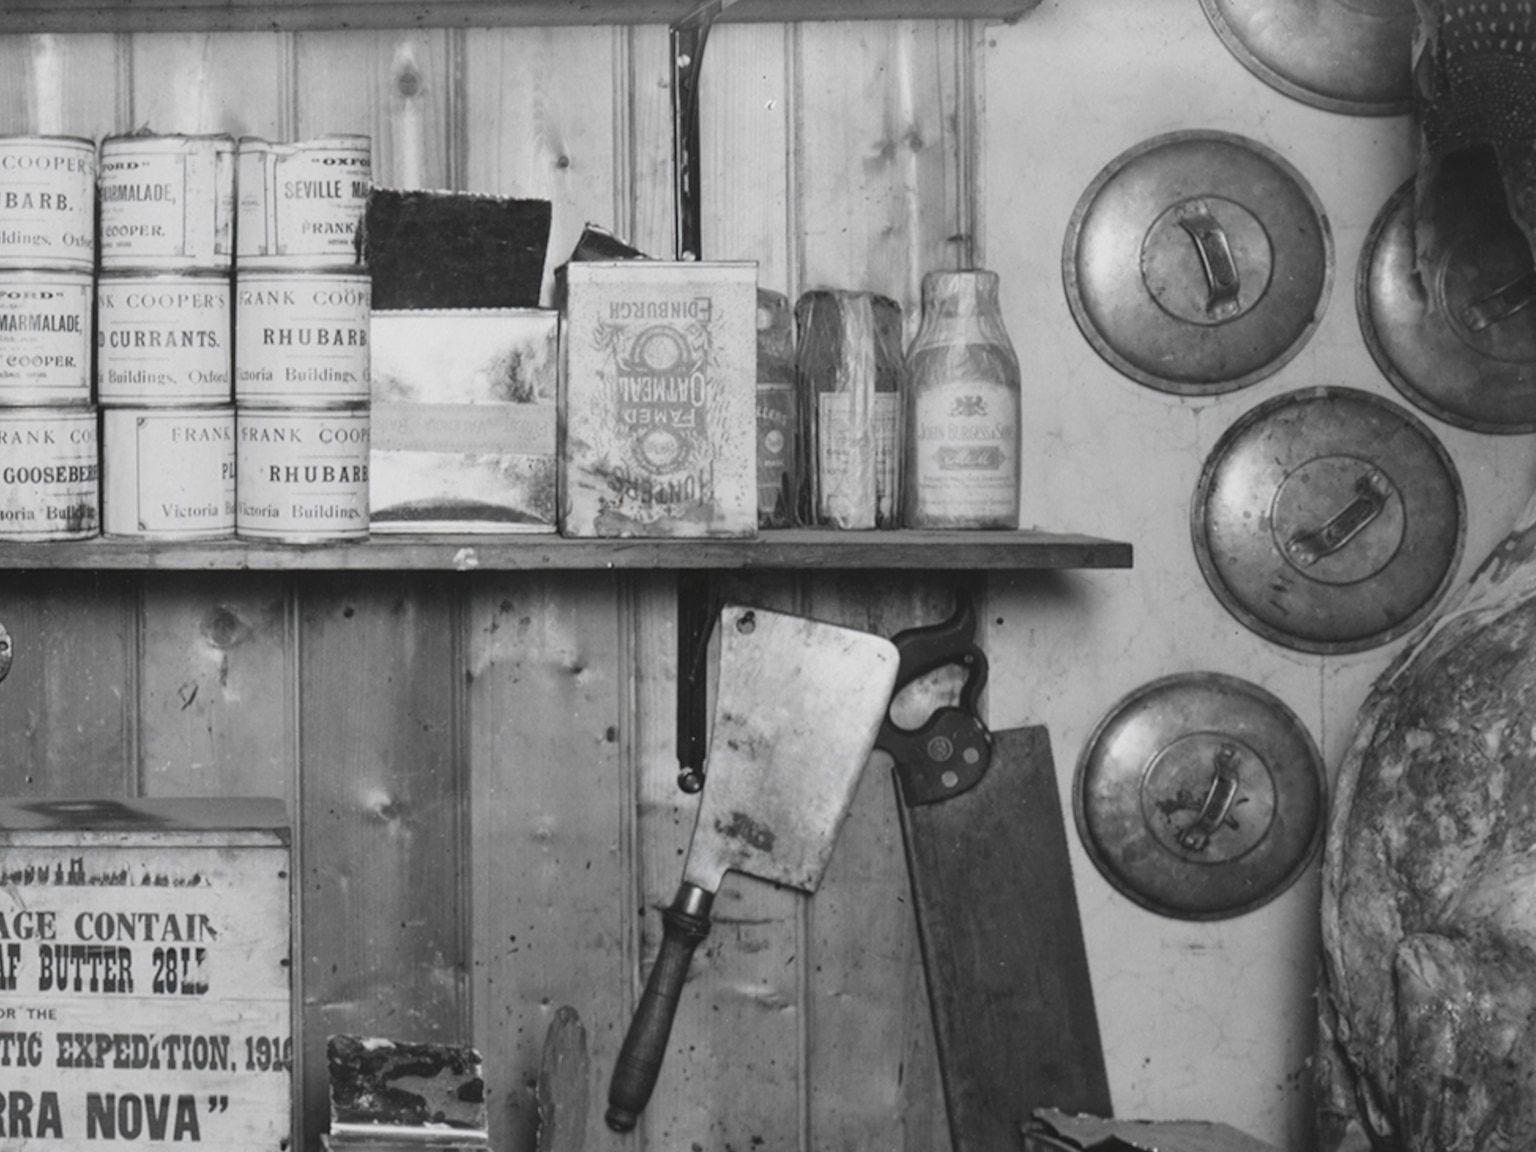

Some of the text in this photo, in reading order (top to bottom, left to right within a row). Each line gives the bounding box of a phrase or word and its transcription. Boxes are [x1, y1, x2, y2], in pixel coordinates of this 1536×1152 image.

[284, 180, 342, 200] SEVILLE
[609, 297, 712, 323] EDINBURGH
[110, 330, 221, 348] CURRANTS.
[619, 371, 706, 408] OATMEAL
[624, 408, 696, 428] FAMED
[172, 427, 231, 443] FRANK
[161, 503, 219, 519] Victoria
[38, 943, 134, 994] BUTTER
[27, 1008, 57, 1021] THE
[85, 1091, 229, 1142] NOVA"
